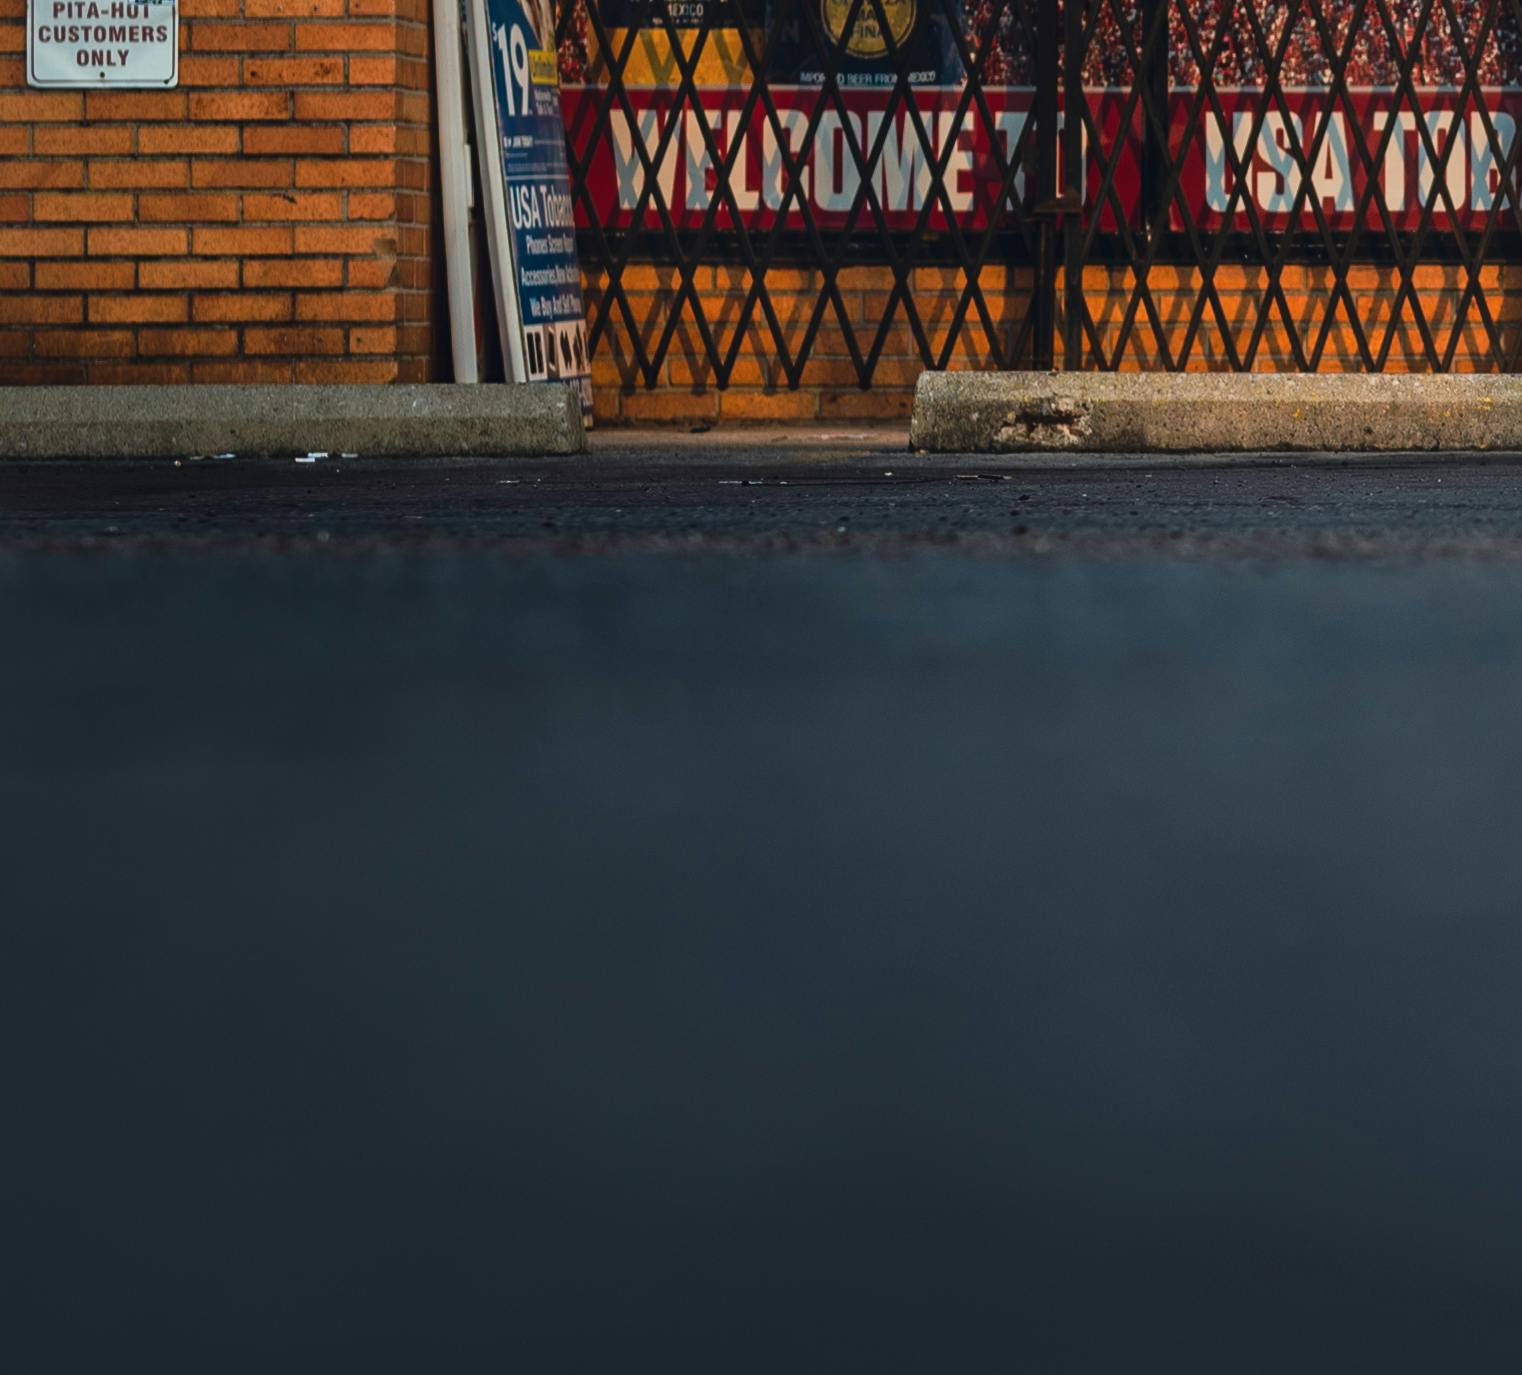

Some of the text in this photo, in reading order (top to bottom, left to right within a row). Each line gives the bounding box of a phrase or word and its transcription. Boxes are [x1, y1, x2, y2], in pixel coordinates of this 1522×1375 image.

[52, 1, 151, 19] PITA-HUT
[38, 25, 168, 43] CUSTOMERS
[76, 49, 130, 67] ONLY
[874, 72, 900, 85] FRO
[610, 108, 975, 211] WELCOME
[1204, 110, 1356, 213] USA
[509, 184, 542, 229] USA
